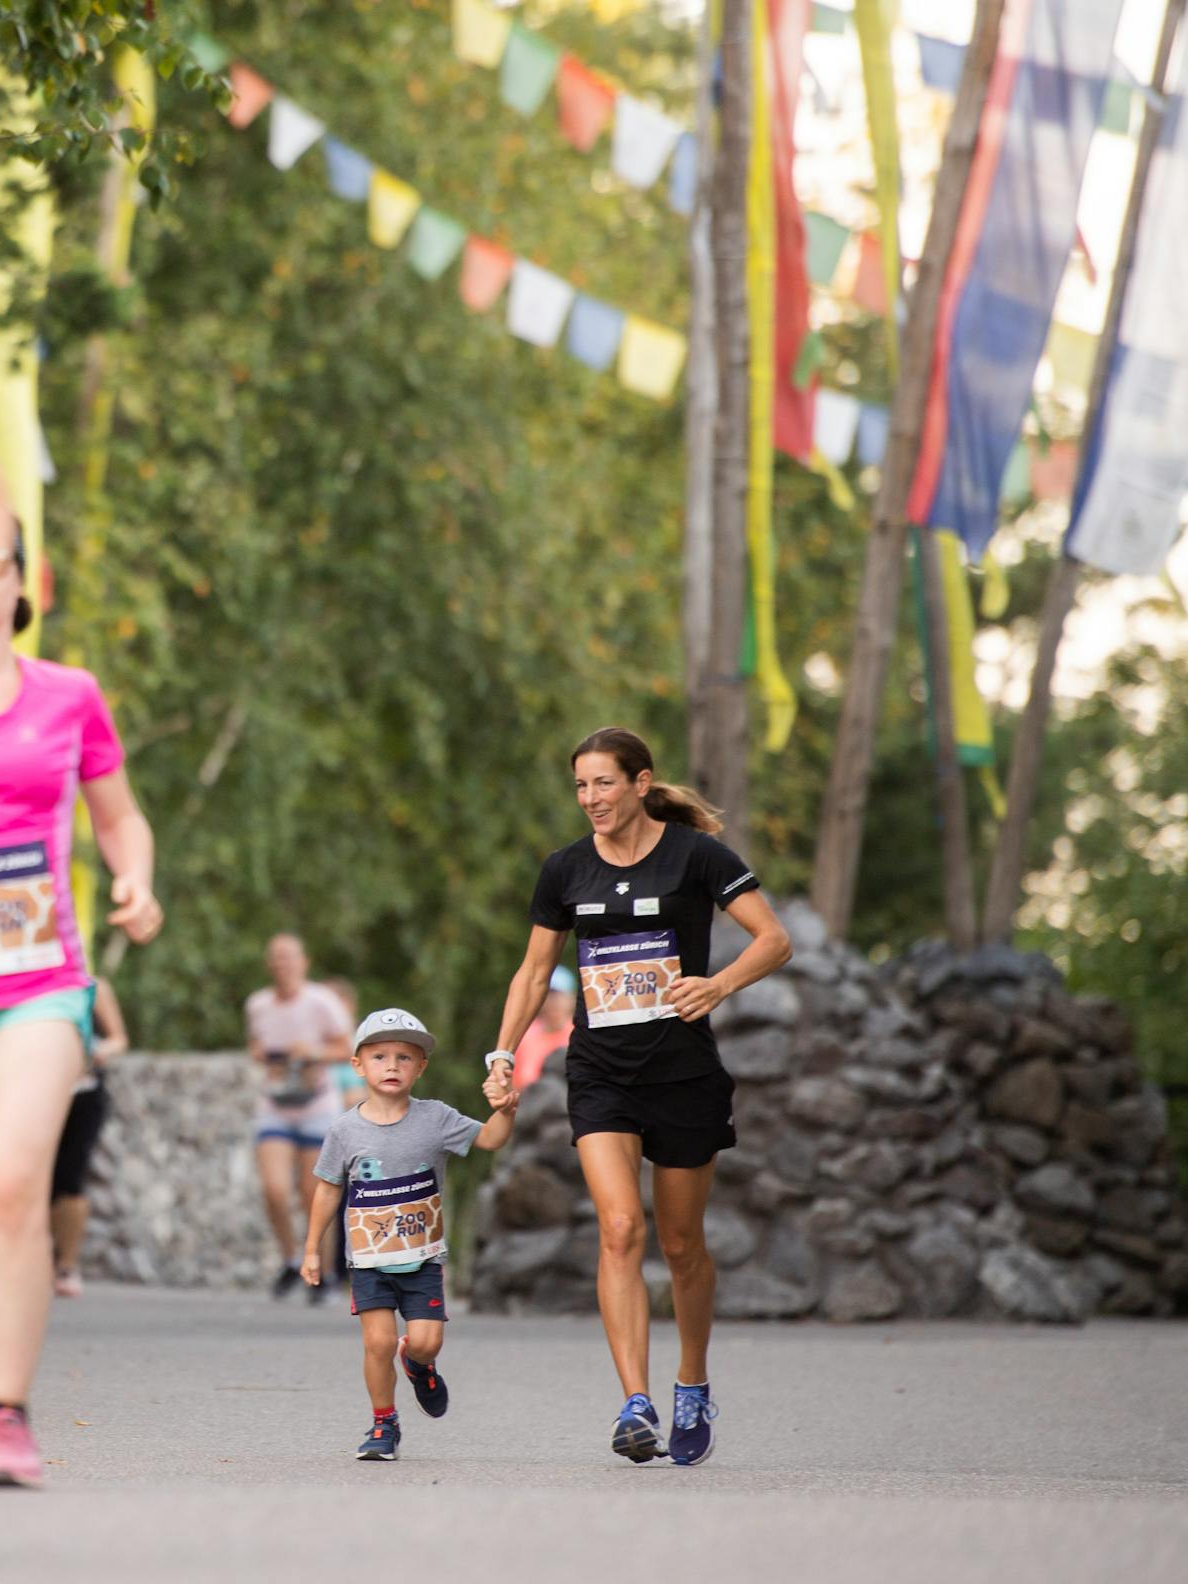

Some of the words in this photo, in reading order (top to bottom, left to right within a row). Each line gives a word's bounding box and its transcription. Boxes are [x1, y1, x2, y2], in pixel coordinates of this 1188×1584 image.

[623, 971, 657, 985] ZOO
[624, 983, 657, 996] RUN
[363, 1185, 411, 1198] WELTKLASSE
[394, 1211, 426, 1227] ZOO
[396, 1224, 426, 1238] RUN
